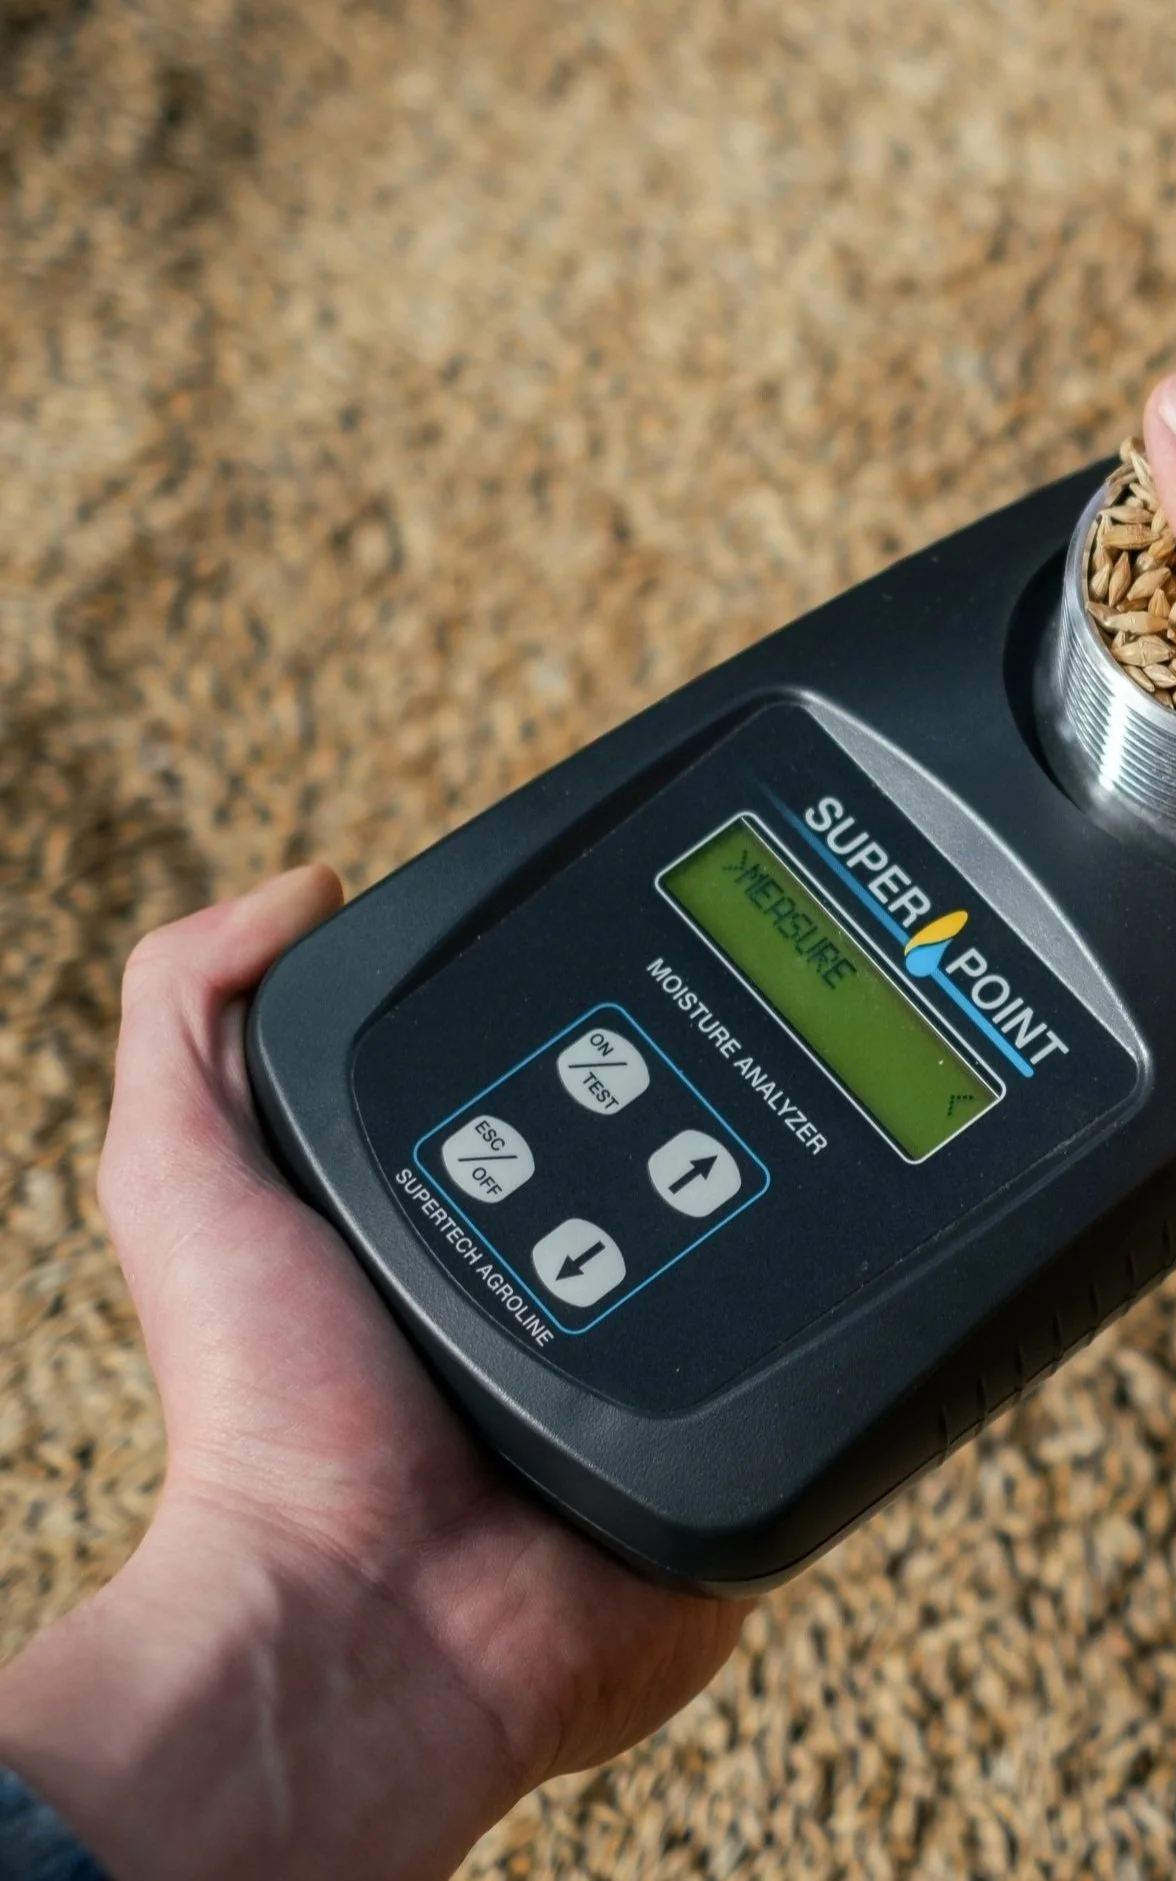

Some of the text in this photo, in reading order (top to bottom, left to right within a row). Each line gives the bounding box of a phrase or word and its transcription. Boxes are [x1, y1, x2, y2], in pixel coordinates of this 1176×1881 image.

[804, 796, 1070, 1065] SUPER POINT
[589, 1032, 615, 1058] ON
[646, 957, 829, 1156] MOISTURE ANALYZER
[581, 1072, 620, 1111] TEST
[474, 1119, 506, 1152] ESC
[471, 1166, 503, 1198] OFF
[395, 1167, 554, 1348] SUPERTECH AGROLINE
